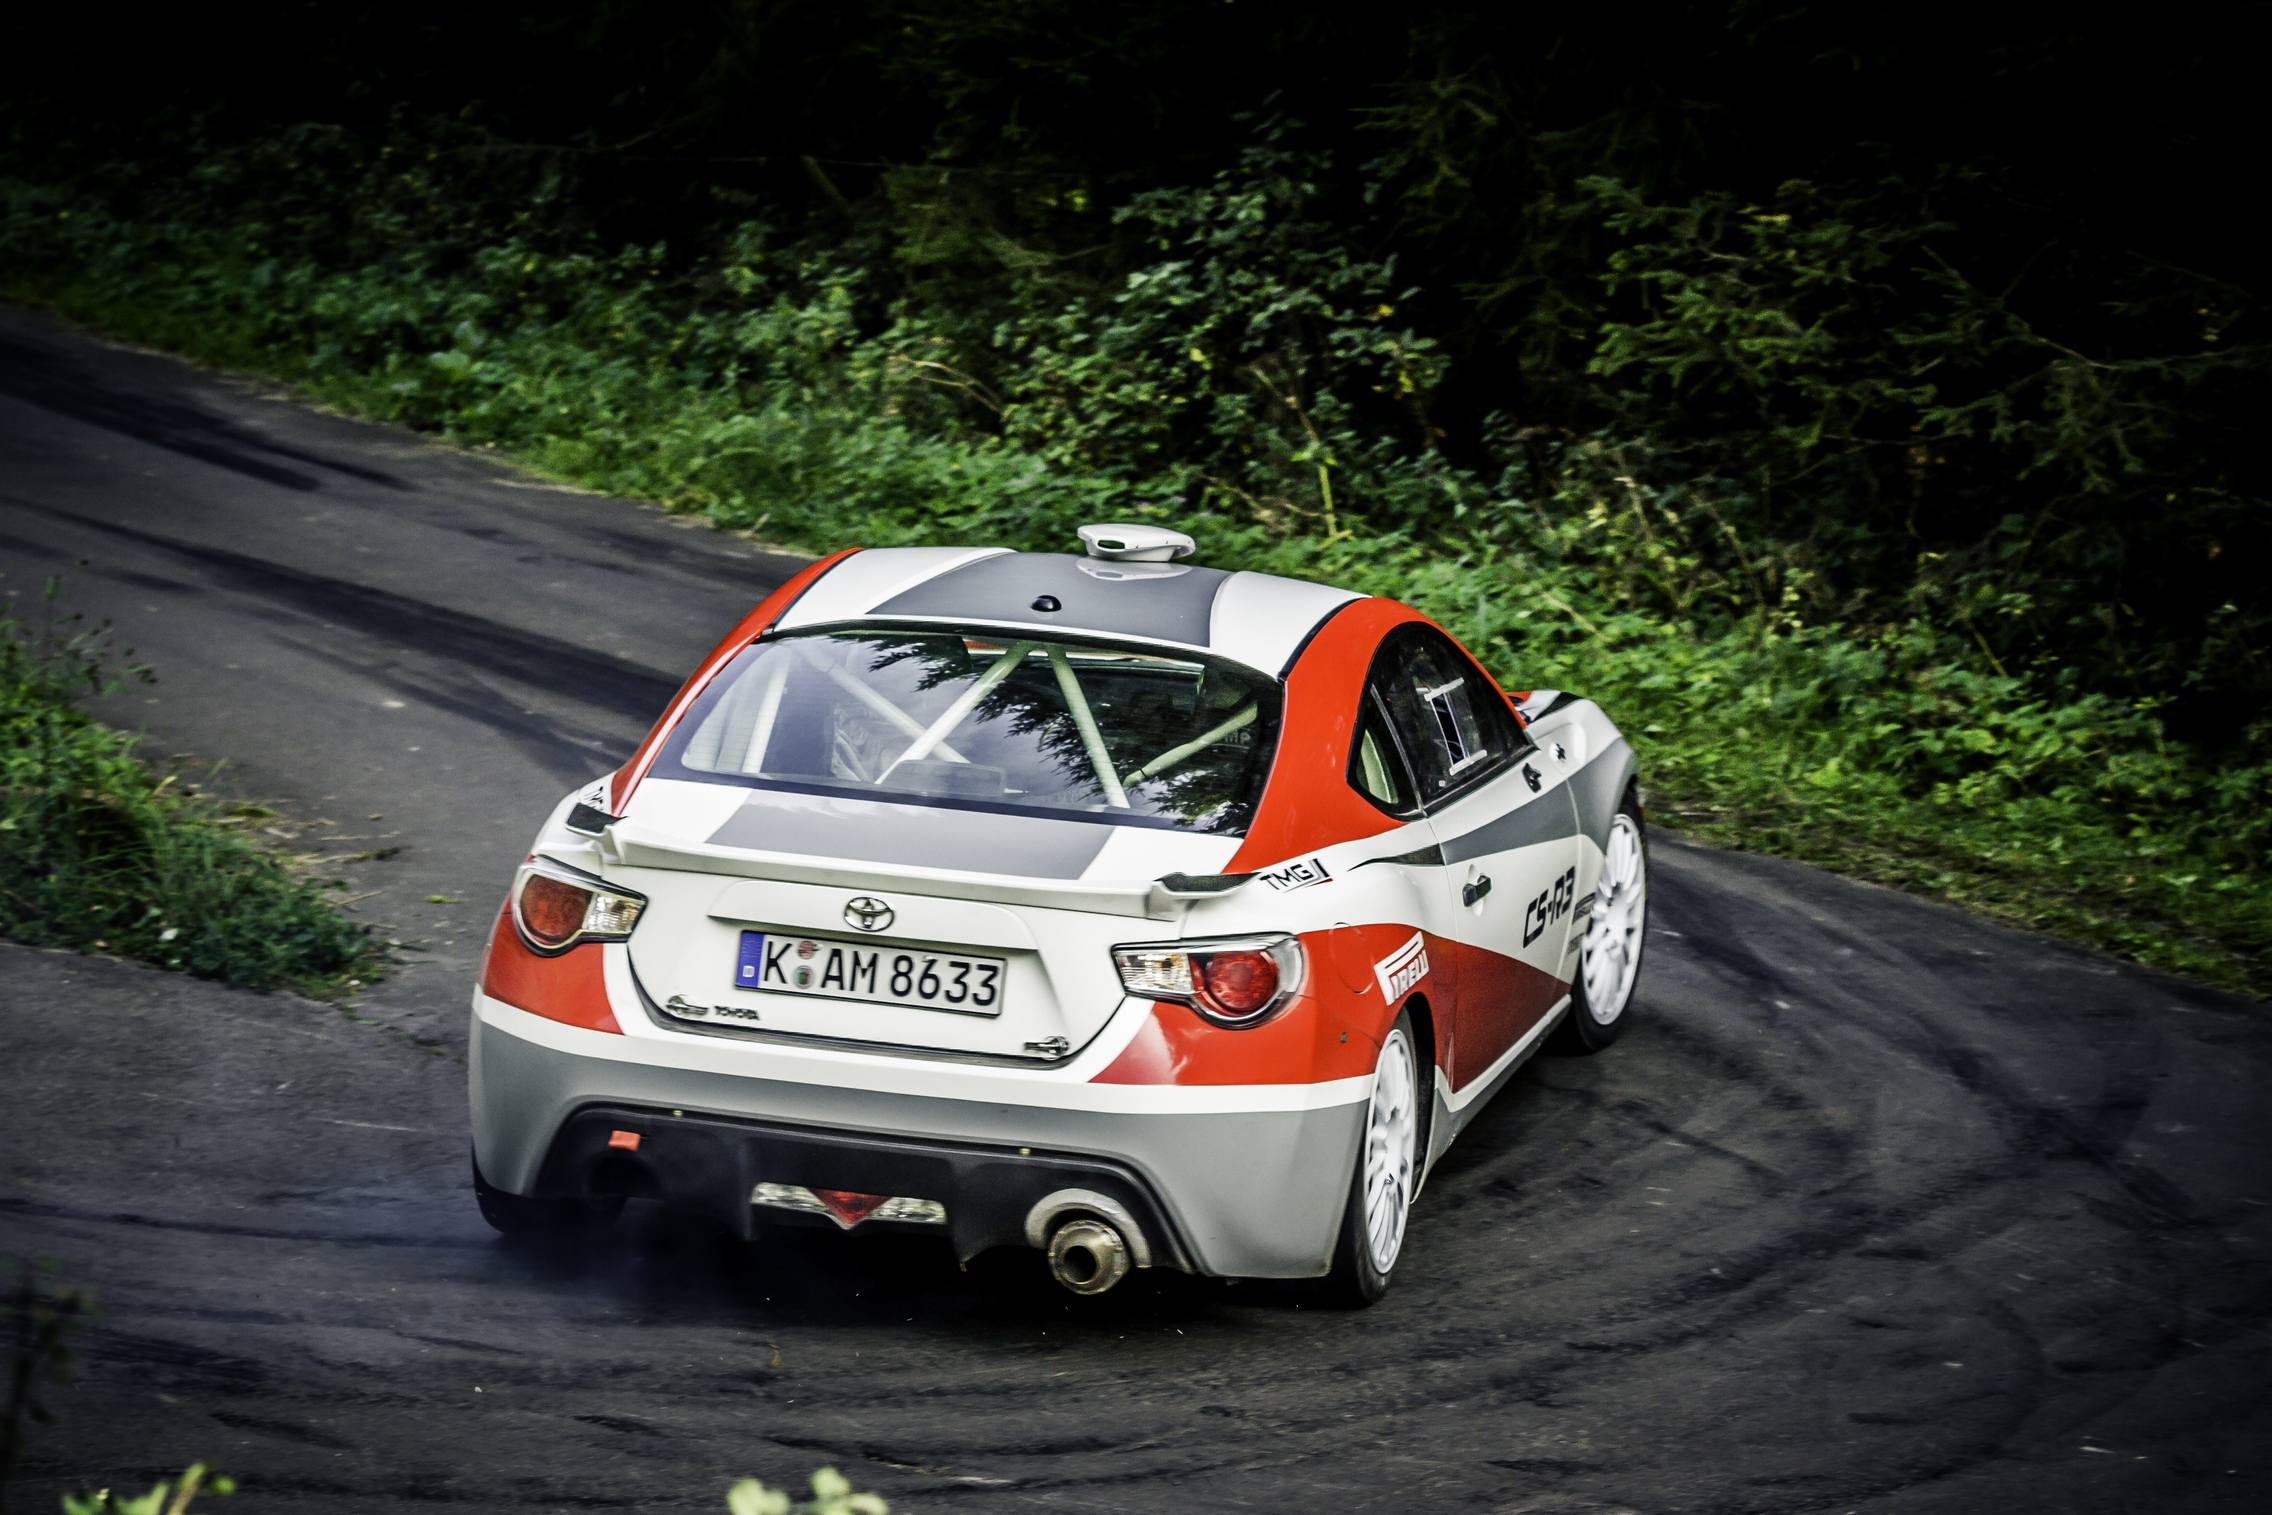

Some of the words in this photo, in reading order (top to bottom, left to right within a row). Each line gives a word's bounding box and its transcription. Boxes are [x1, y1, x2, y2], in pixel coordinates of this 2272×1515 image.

[1522, 866, 1576, 949] CS-R3
[764, 940, 793, 984] K
[820, 948, 880, 994] AM
[890, 954, 1000, 1007] 8633
[1373, 930, 1430, 1006] PIRELLI
